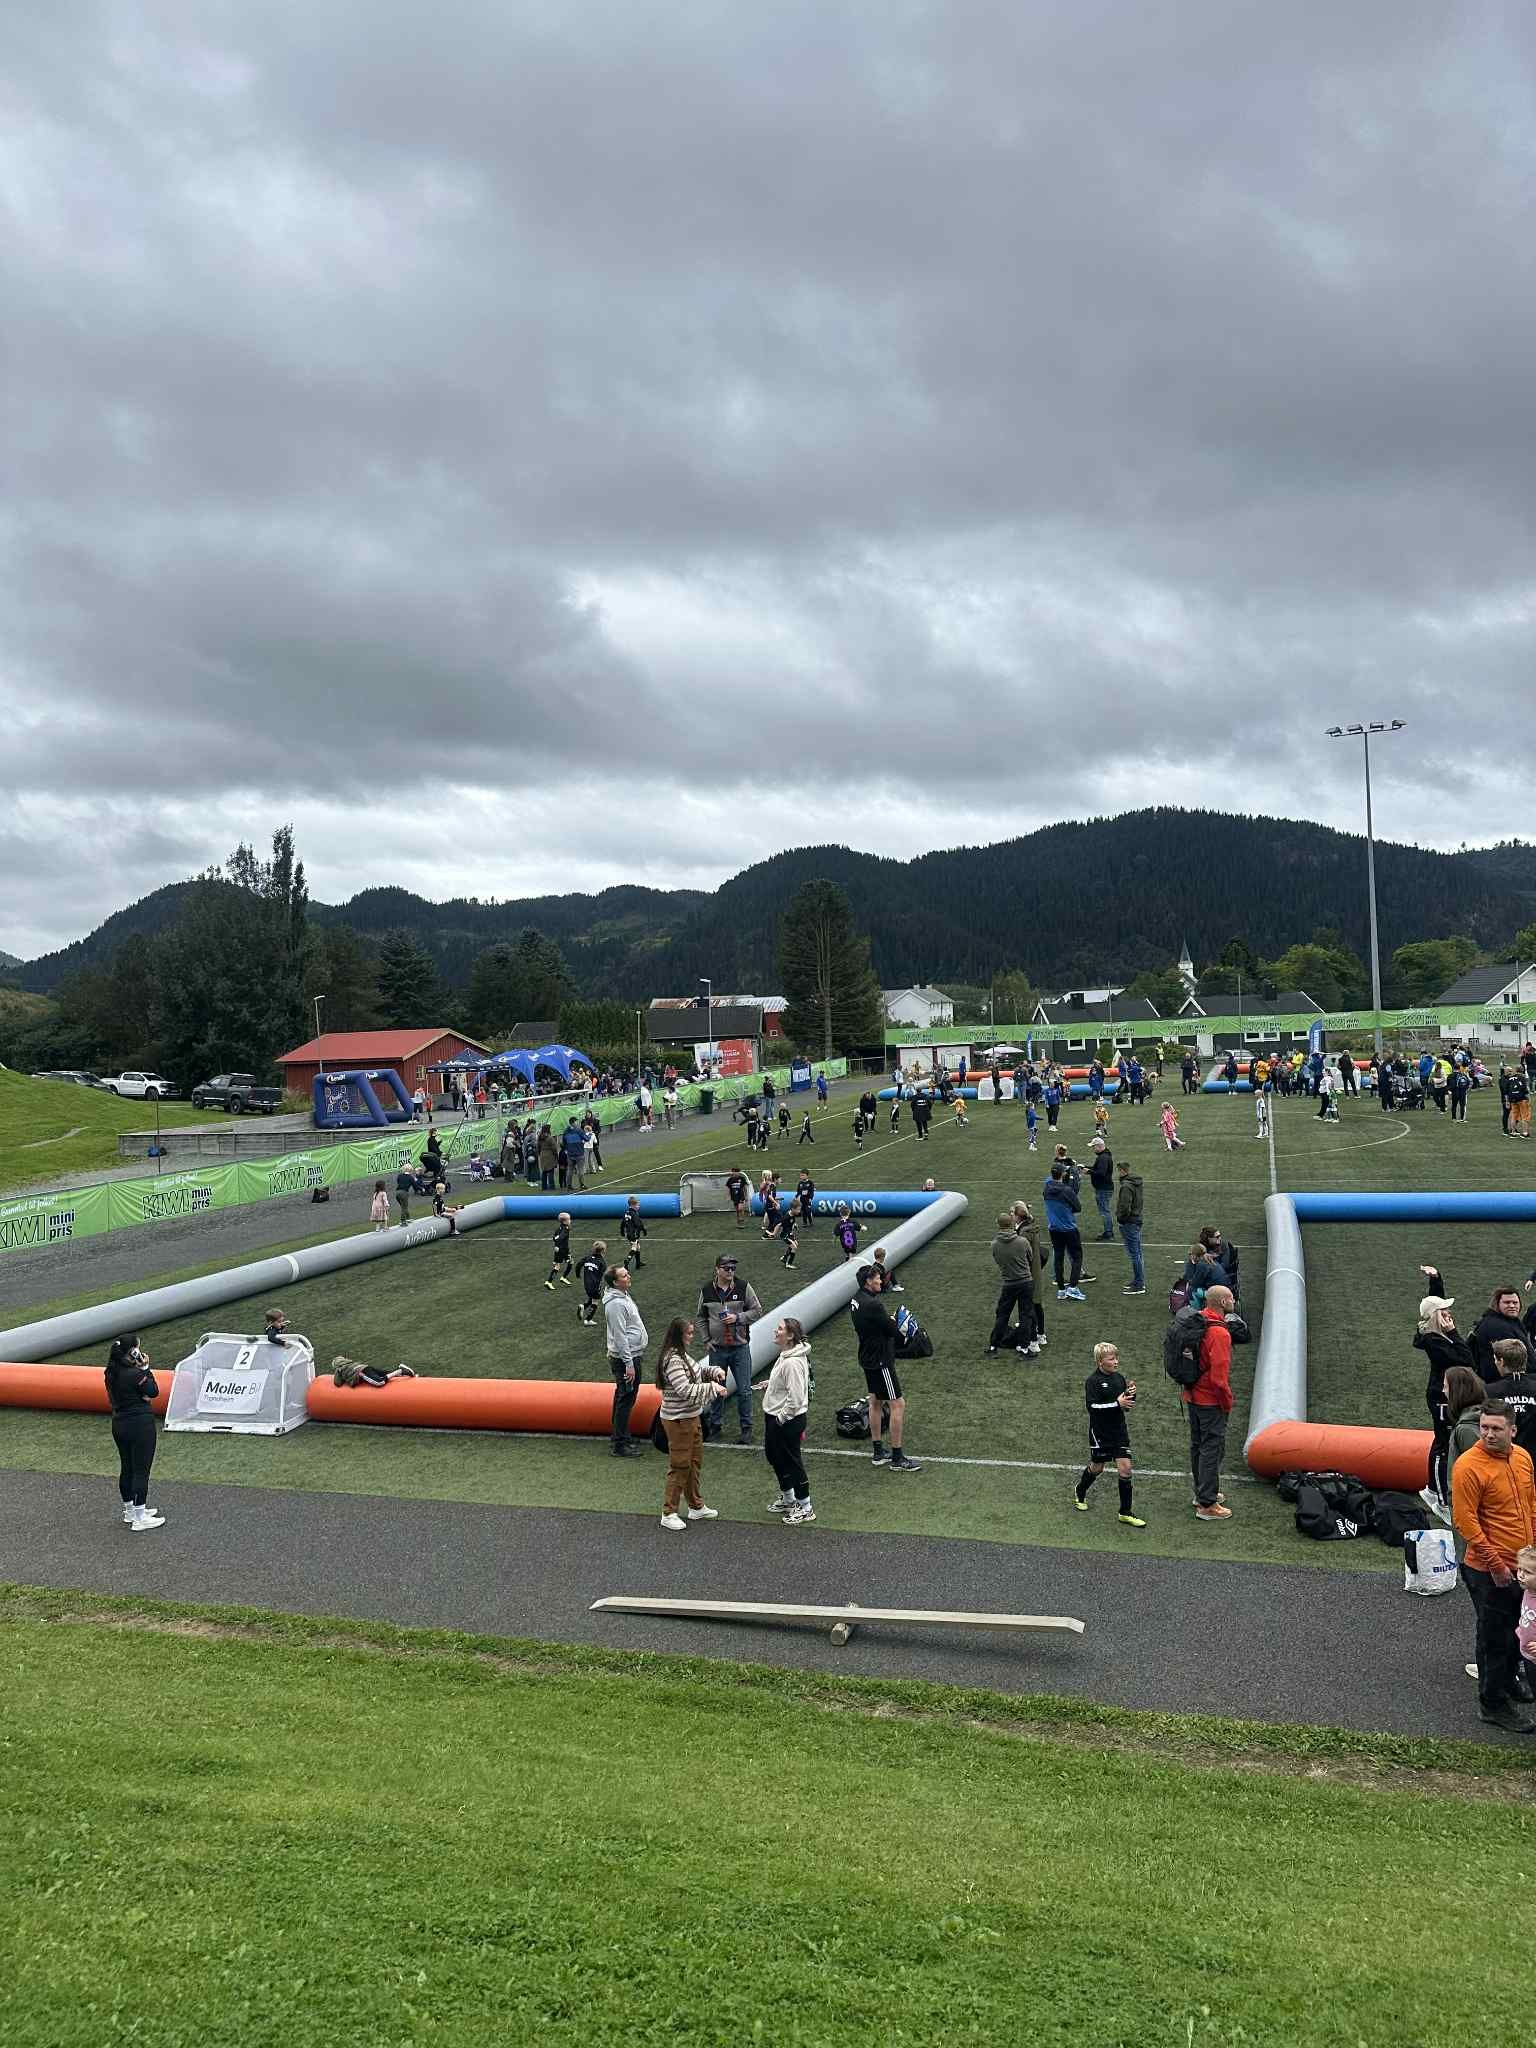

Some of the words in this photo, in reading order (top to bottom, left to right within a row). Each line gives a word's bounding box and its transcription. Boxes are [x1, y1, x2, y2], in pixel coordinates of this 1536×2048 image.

[367, 1149, 398, 1174] KIWI
[268, 1166, 305, 1195] KIWI
[307, 1164, 324, 1176] mini
[307, 1175, 323, 1188] pris
[143, 1188, 190, 1220] KIWI
[191, 1184, 213, 1199] mini
[191, 1197, 210, 1212] pris
[852, 1199, 877, 1213] NO
[49, 1208, 75, 1226] mini
[49, 1223, 73, 1241] pris
[843, 1230, 854, 1247] 8
[239, 1351, 250, 1365] 2
